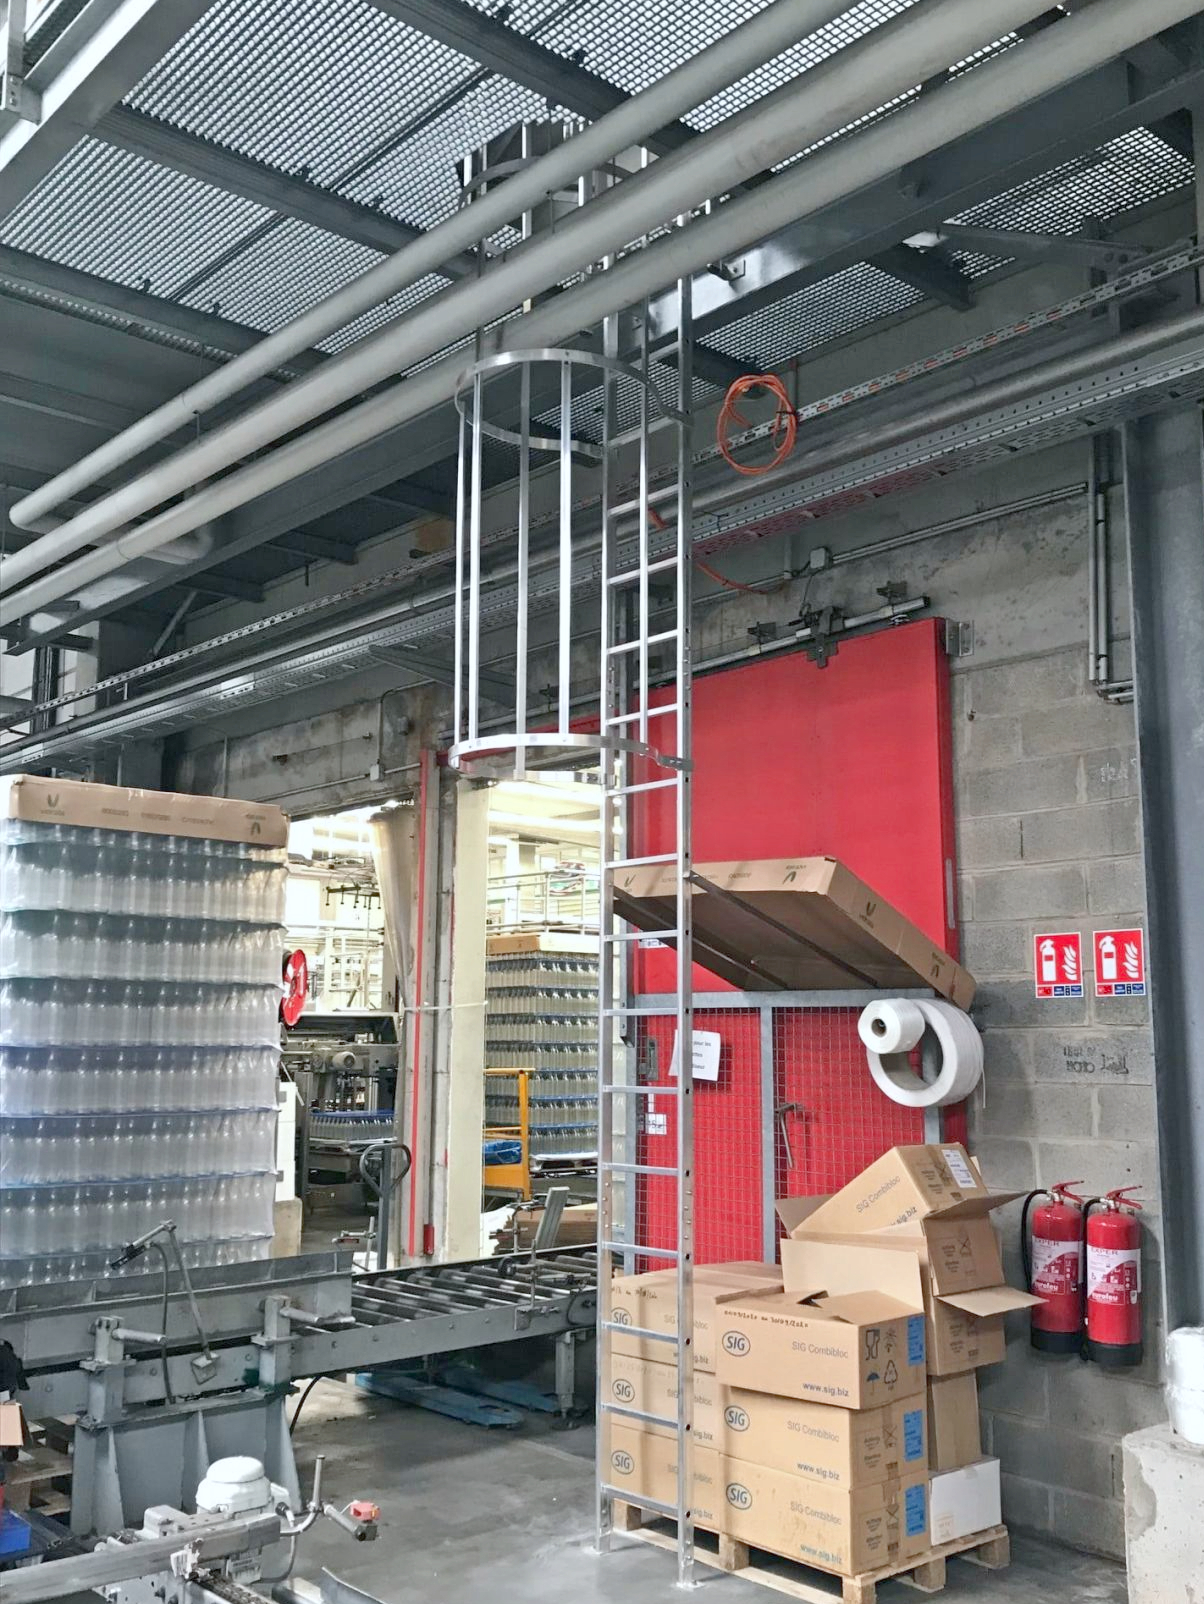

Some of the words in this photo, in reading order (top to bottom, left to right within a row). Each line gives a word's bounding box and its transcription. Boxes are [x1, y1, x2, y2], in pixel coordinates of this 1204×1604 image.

[856, 1199, 869, 1213] SIG
[868, 1176, 900, 1203] Combibloc
[726, 1336, 745, 1351] SIG
[791, 1341, 806, 1352] SIG
[808, 1343, 849, 1359] Combibloc
[616, 1383, 631, 1398] SIG
[802, 1383, 849, 1397] www.sig.biz
[728, 1411, 746, 1427] SIG
[787, 1420, 801, 1432] SIG
[802, 1424, 840, 1443] Combibloc
[615, 1455, 630, 1469] SIG
[797, 1463, 840, 1481] www.sig.biz
[729, 1488, 748, 1505] SIG
[790, 1501, 804, 1513] SIG
[804, 1506, 842, 1525] Combibloc
[800, 1544, 842, 1565] www.sig.biz
